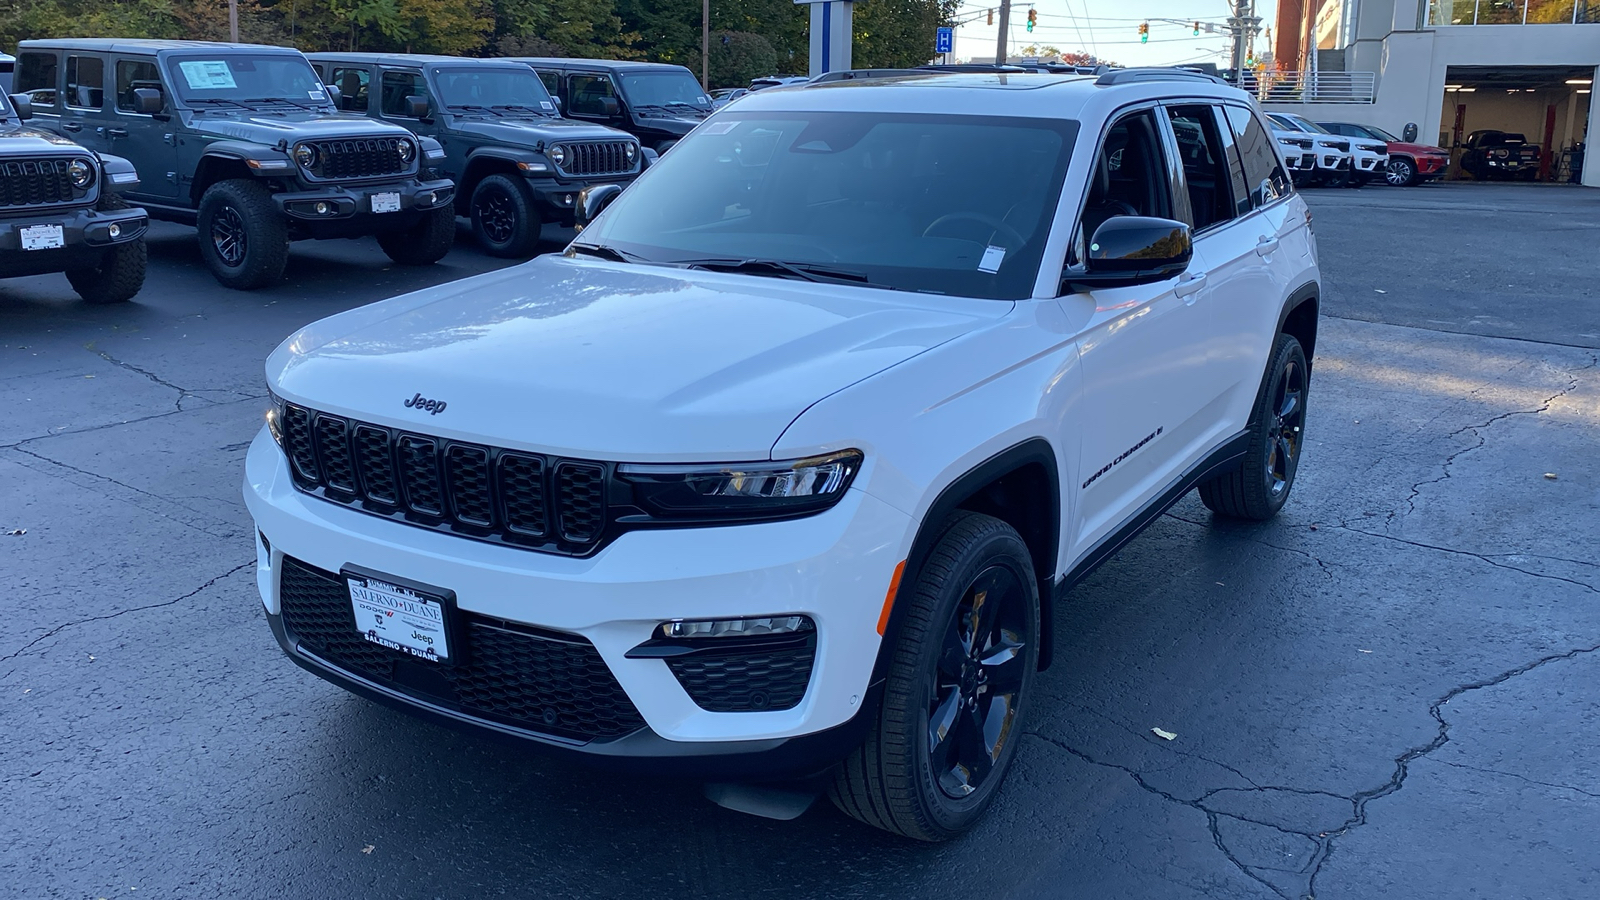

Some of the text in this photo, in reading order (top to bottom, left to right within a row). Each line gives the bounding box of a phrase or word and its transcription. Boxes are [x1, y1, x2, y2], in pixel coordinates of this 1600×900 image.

[940, 33, 949, 46] H
[403, 392, 447, 416] Jeep
[352, 587, 441, 621] SALERNO DUANE
[364, 633, 439, 663] SALERNO DUANE
[411, 630, 434, 646] Jeep
